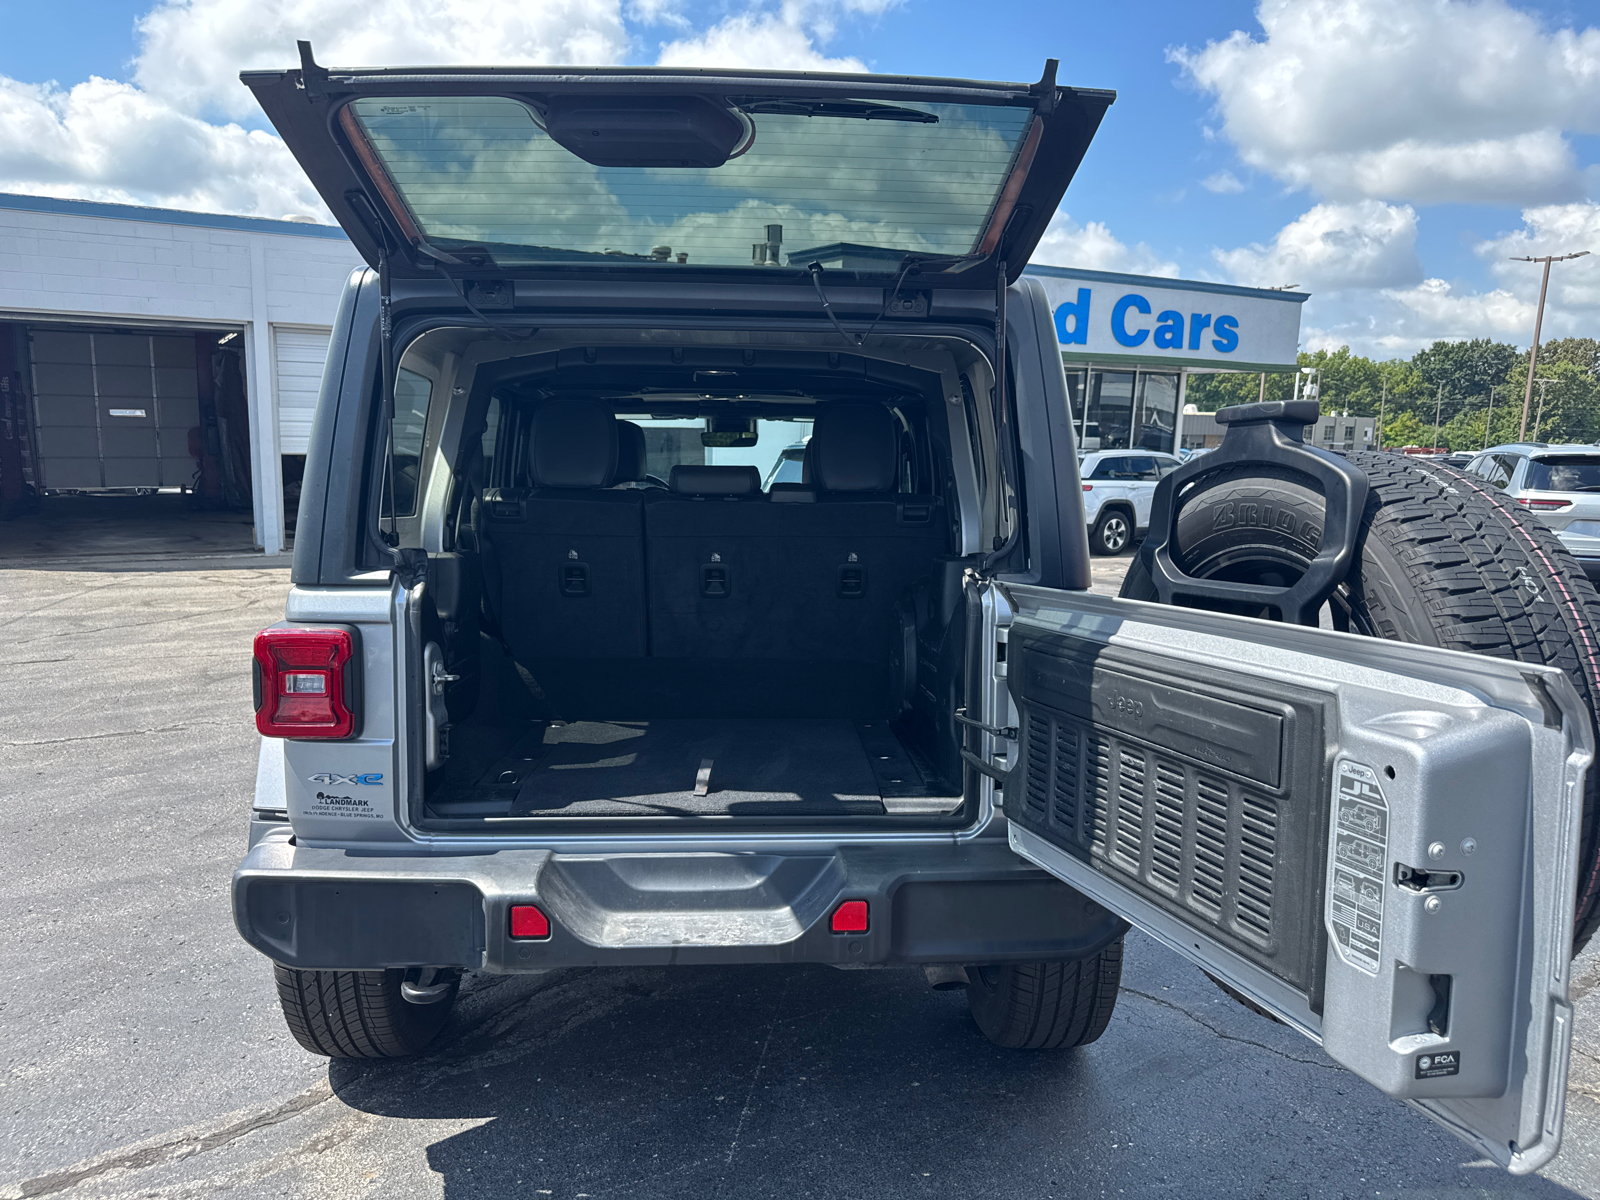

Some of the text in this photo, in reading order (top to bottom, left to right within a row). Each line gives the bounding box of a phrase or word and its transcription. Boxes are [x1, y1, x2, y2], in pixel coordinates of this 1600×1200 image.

[1111, 293, 1239, 353] Cars
[1108, 689, 1144, 721] Jeep
[1348, 765, 1365, 778] Jeep
[1340, 780, 1382, 800] JL
[324, 799, 369, 807] LANDMARK
[1434, 1054, 1455, 1064] FCA
